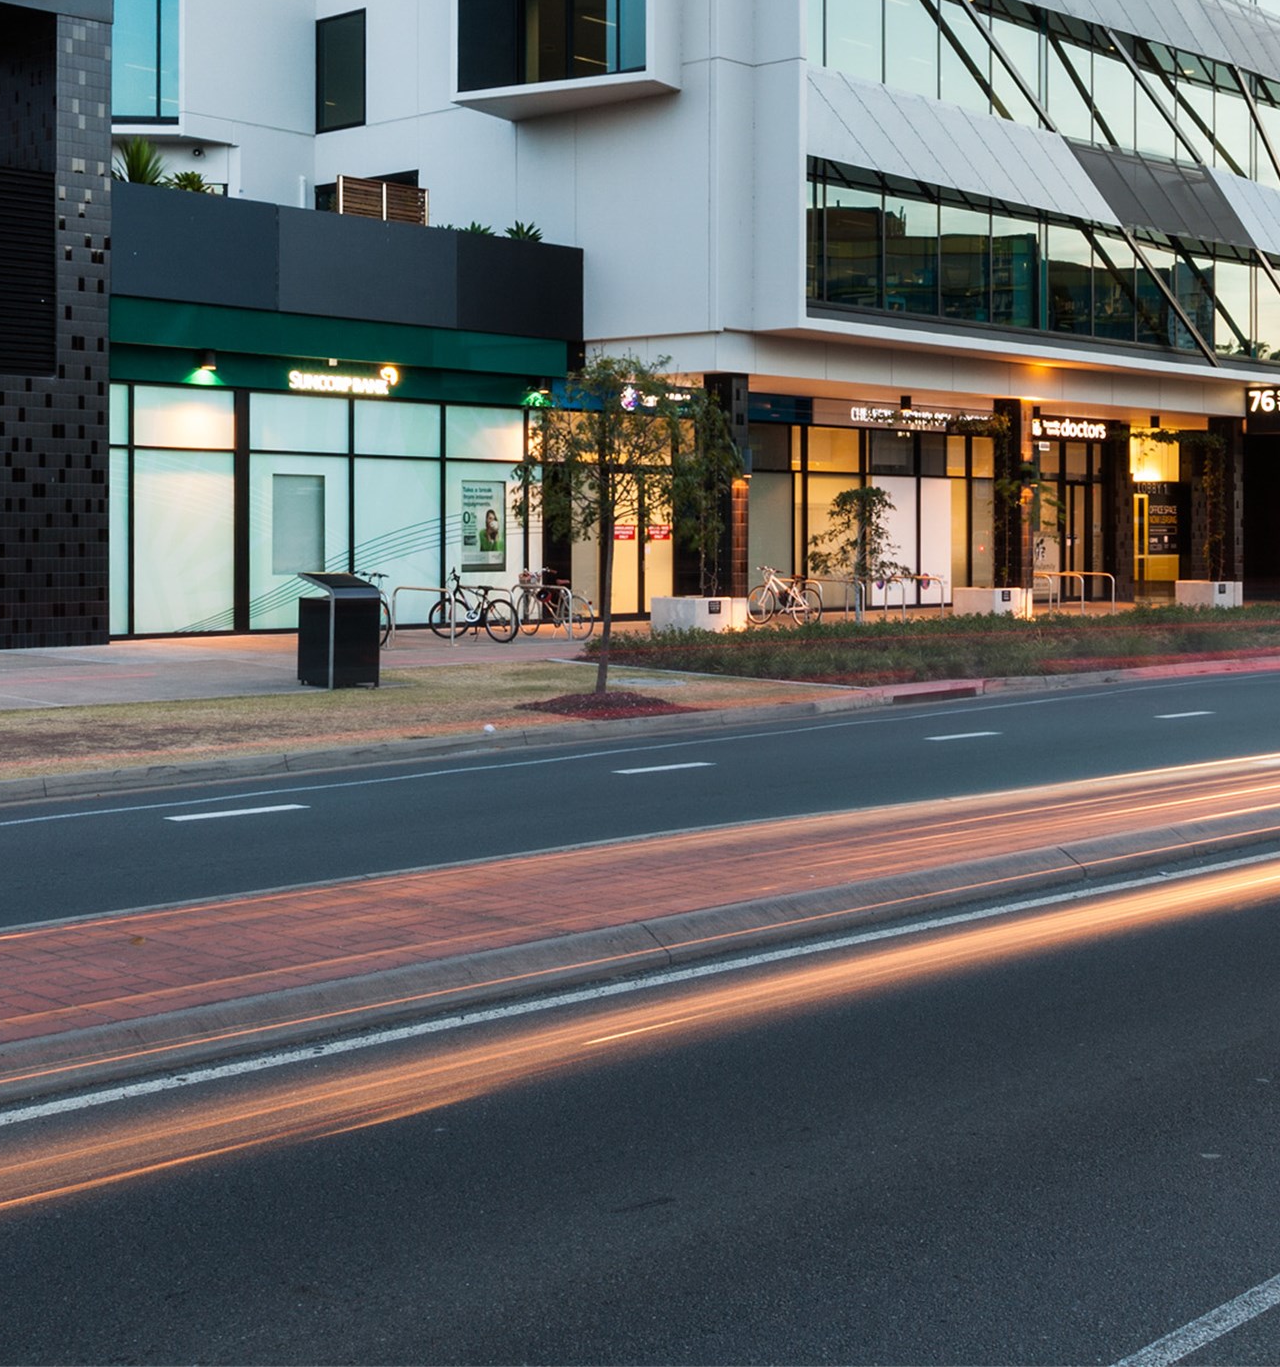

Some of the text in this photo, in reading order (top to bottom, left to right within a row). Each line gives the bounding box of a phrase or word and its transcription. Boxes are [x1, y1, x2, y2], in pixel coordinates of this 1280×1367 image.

[352, 377, 389, 395] BANK
[1248, 390, 1275, 412] 76
[1060, 418, 1107, 440] doctors
[1137, 482, 1161, 495] LOBBY
